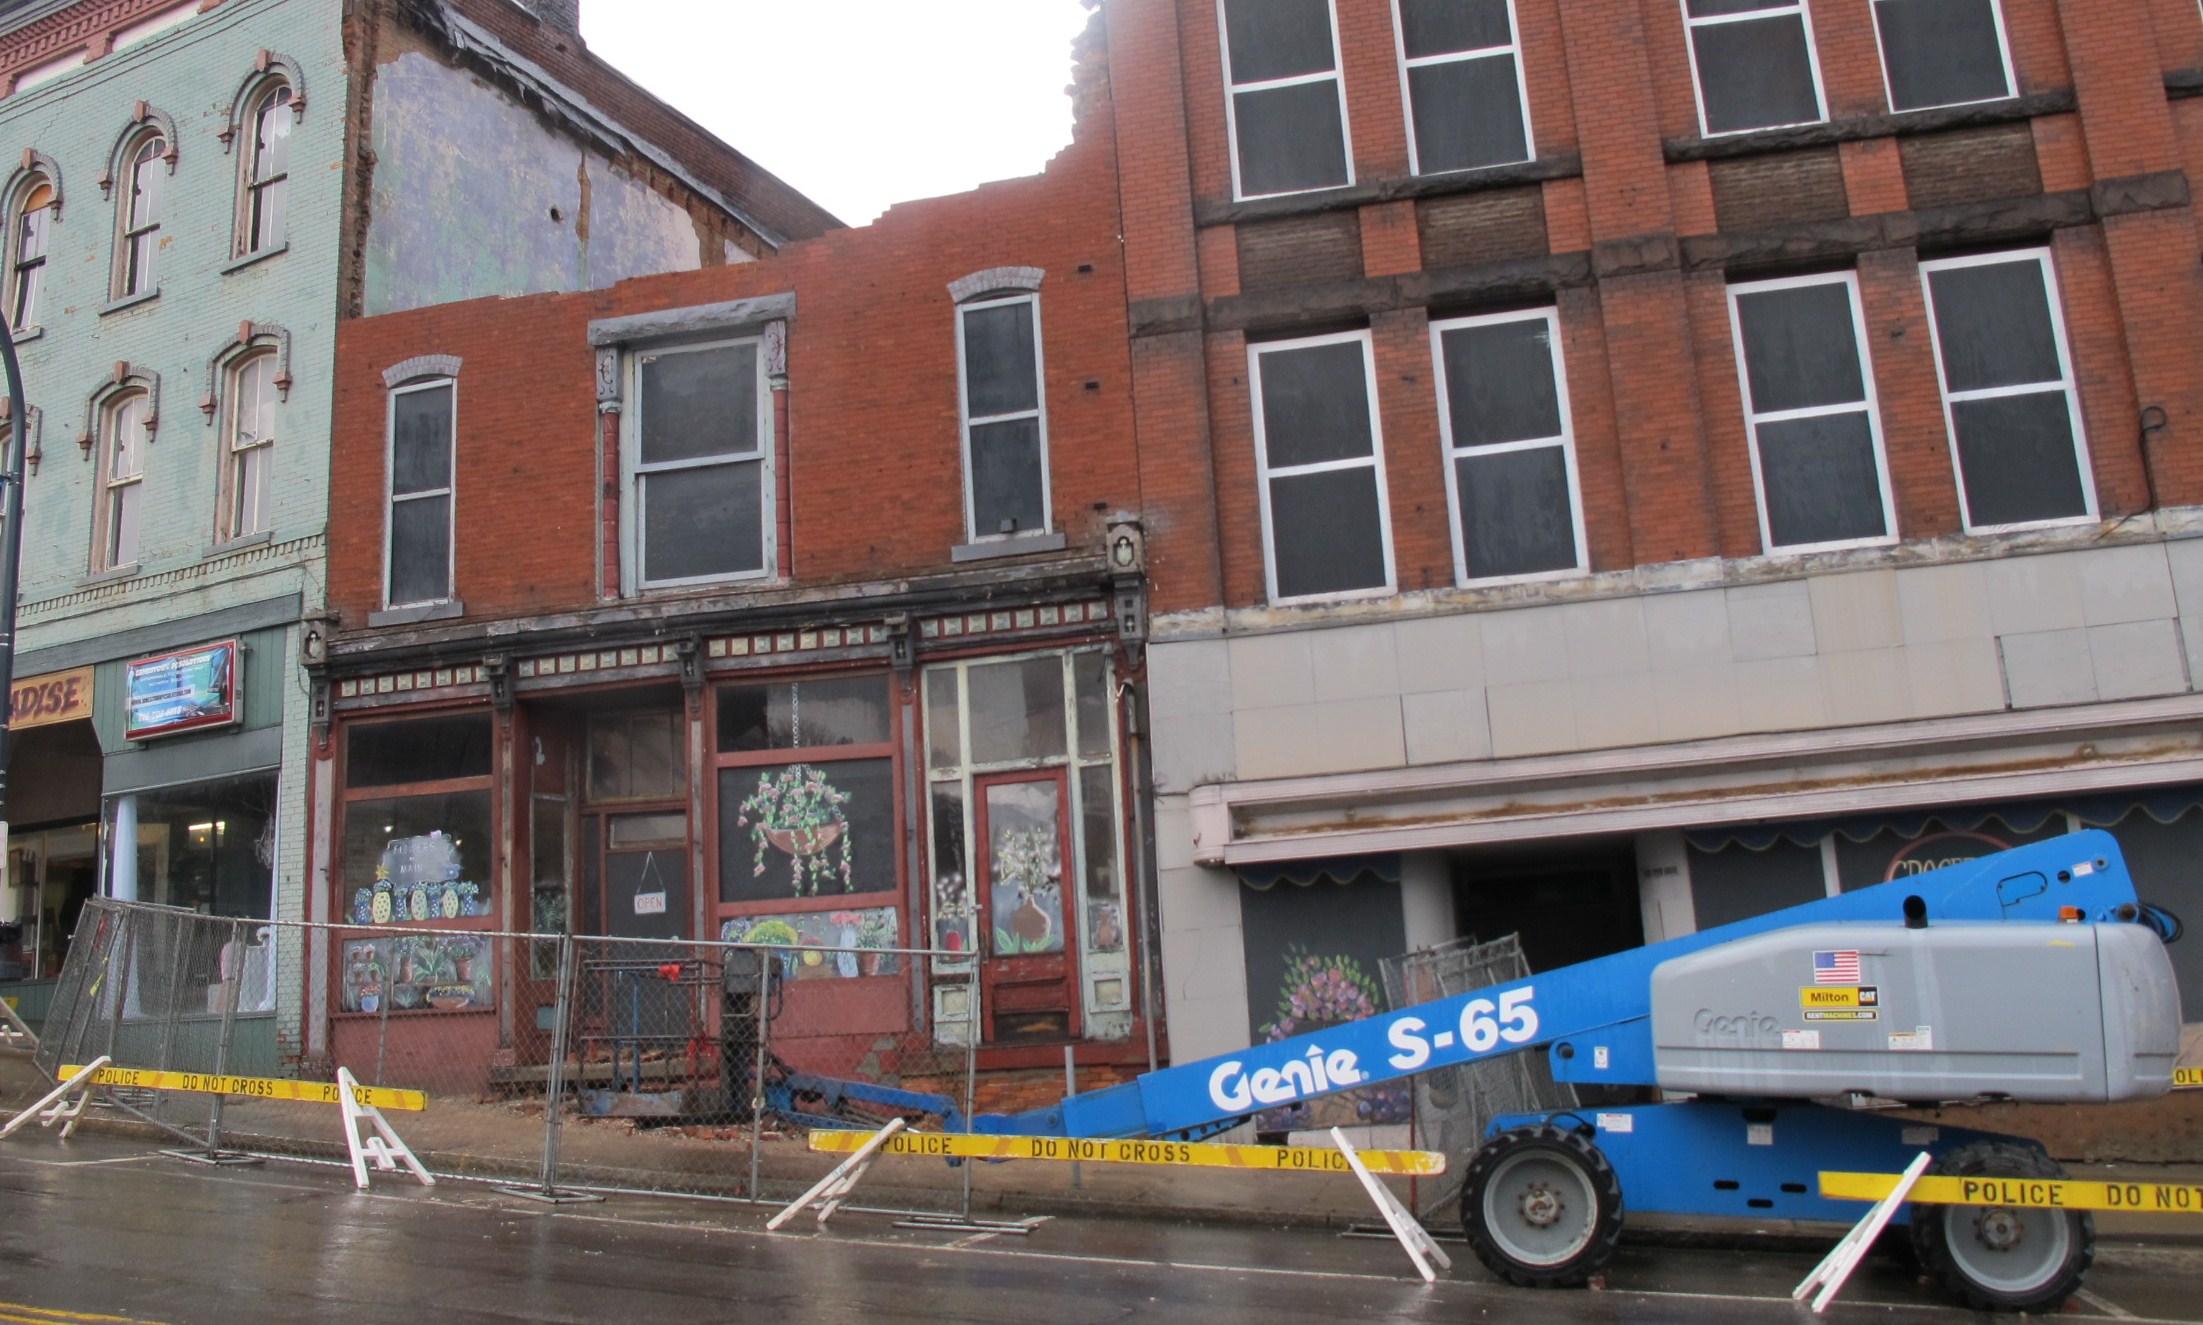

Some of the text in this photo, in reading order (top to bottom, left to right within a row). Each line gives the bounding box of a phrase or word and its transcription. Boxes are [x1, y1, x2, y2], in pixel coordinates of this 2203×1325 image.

[637, 896, 662, 909] OPEN
[1811, 991, 1876, 1002] Milton CAT
[1387, 986, 1538, 1070] S-65
[97, 1068, 373, 1105] POLICE DO NOT CROSS POCE
[1209, 1044, 1362, 1112] Genie
[1031, 1139, 1057, 1157] DO
[1068, 1140, 1108, 1159] NOT
[1120, 1143, 1190, 1162] CROSS
[1963, 1180, 2064, 1206] POLICE
[2107, 1184, 2141, 1206] DO
